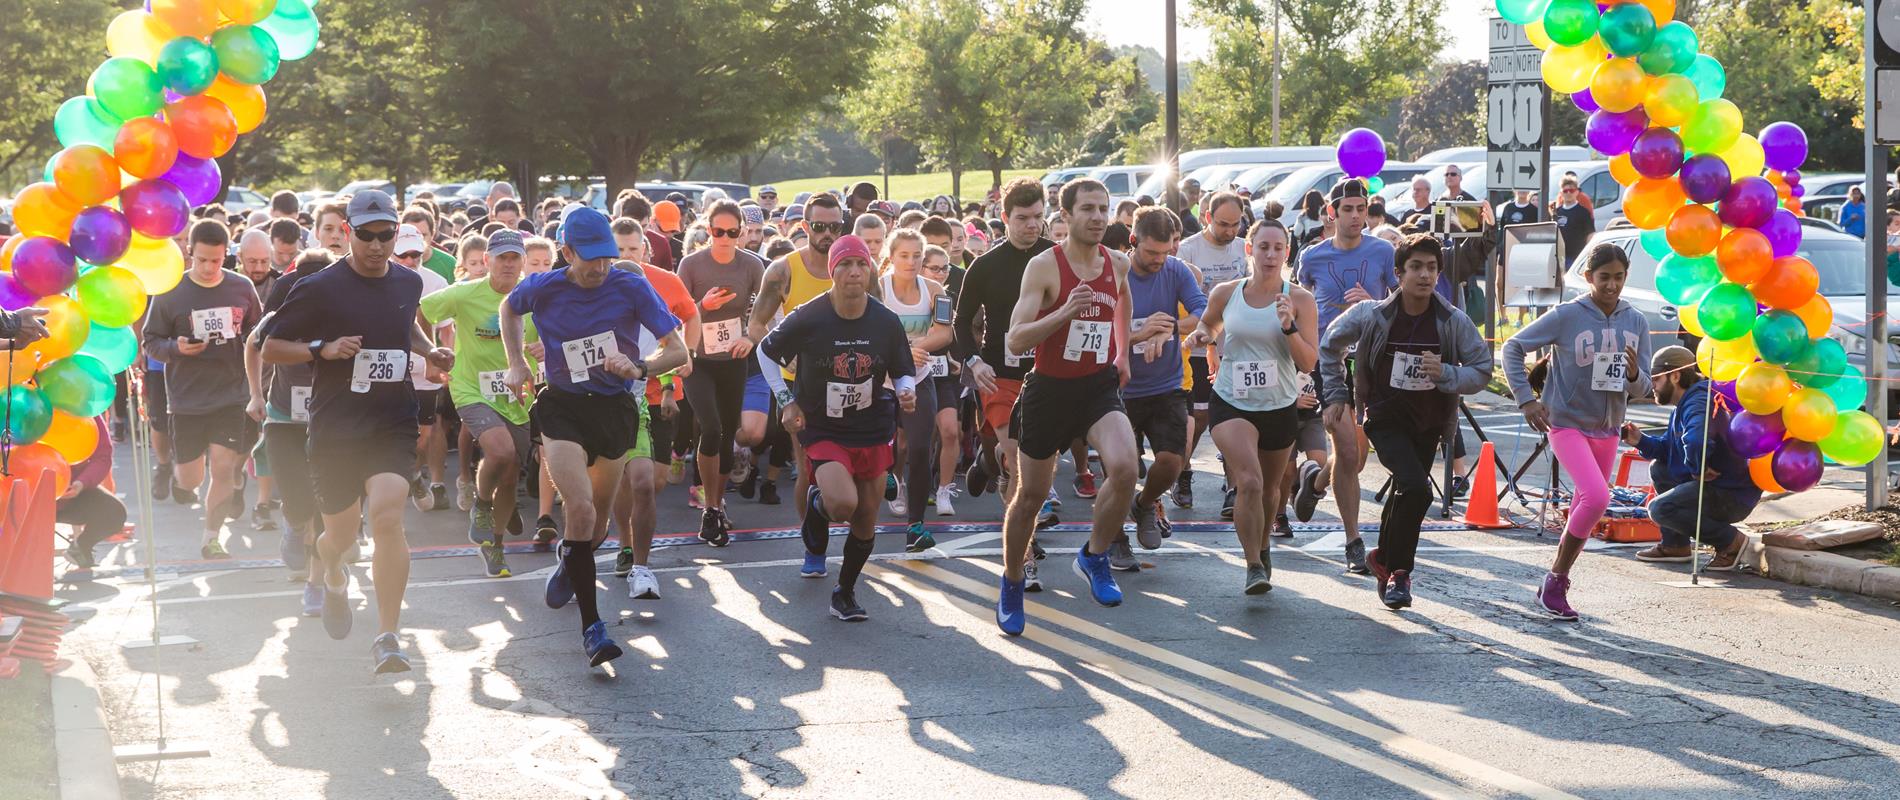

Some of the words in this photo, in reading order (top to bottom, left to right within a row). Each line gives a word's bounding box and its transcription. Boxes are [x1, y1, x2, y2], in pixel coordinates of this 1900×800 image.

[1496, 22, 1508, 40] TO
[1489, 55, 1513, 73] SOUTH
[1516, 54, 1541, 72] NORTH
[1499, 98, 1503, 132] 1
[1526, 97, 1531, 132] 1
[204, 318, 224, 331] 586
[718, 322, 727, 330] 5K
[1090, 323, 1098, 333] 5K
[717, 329, 730, 342] 35
[1081, 333, 1103, 350] 713
[583, 338, 595, 349] 5K
[1574, 328, 1640, 368] GAP
[377, 352, 388, 362] 5K
[581, 346, 606, 366] 174
[1413, 357, 1423, 366] 5K
[1613, 354, 1623, 363] 5K
[368, 363, 394, 380] 236
[931, 364, 944, 376] 380
[1250, 363, 1259, 371] 5K
[495, 371, 505, 380] 5K
[1244, 372, 1266, 387] 518
[491, 380, 509, 393] 63
[846, 386, 856, 394] 5K
[840, 392, 862, 407] 702
